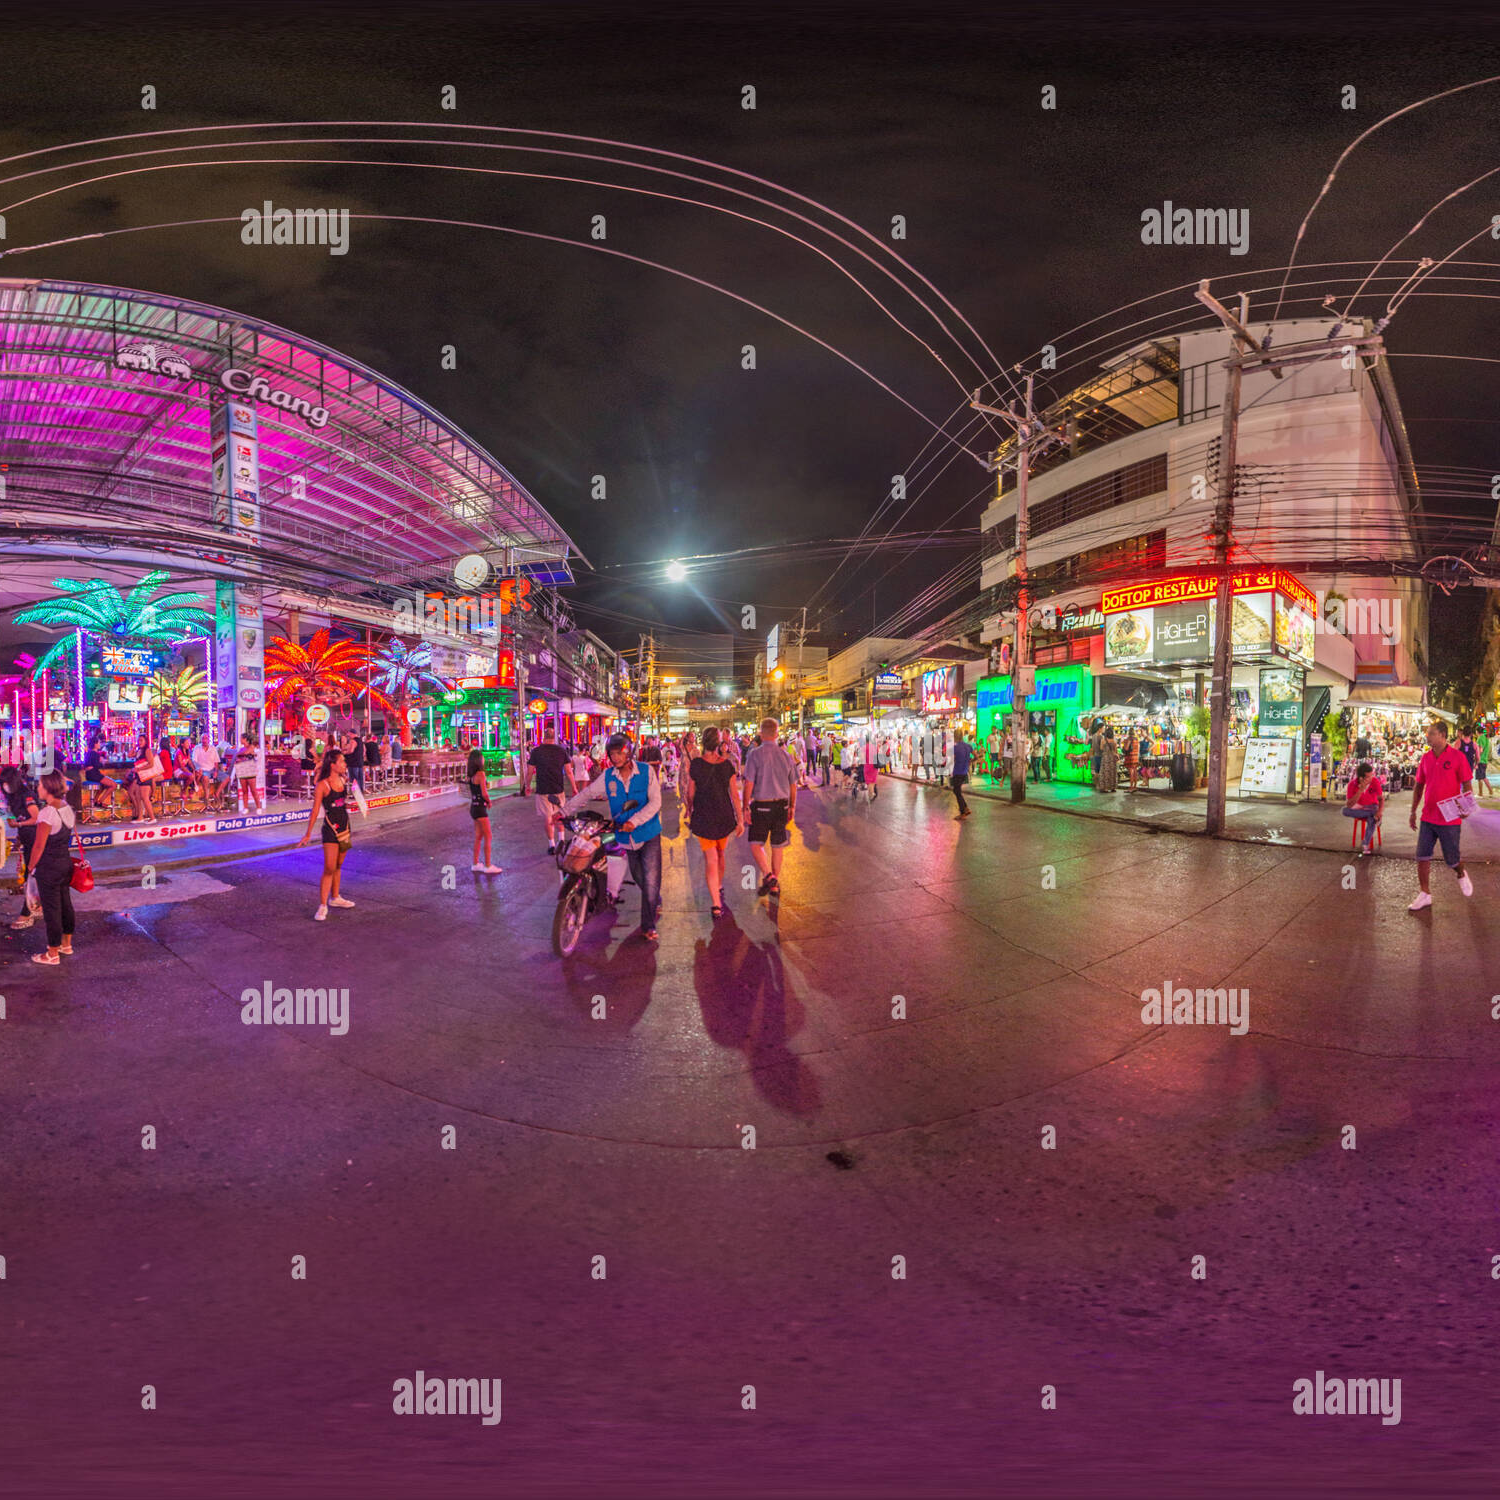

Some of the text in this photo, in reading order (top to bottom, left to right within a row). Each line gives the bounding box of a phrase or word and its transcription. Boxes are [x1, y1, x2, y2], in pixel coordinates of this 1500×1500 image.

[221, 368, 331, 428] Chang
[217, 819, 243, 831] Pole
[245, 813, 284, 826] Dancer
[71, 834, 109, 847] Beer
[123, 823, 207, 842] Live Sports
